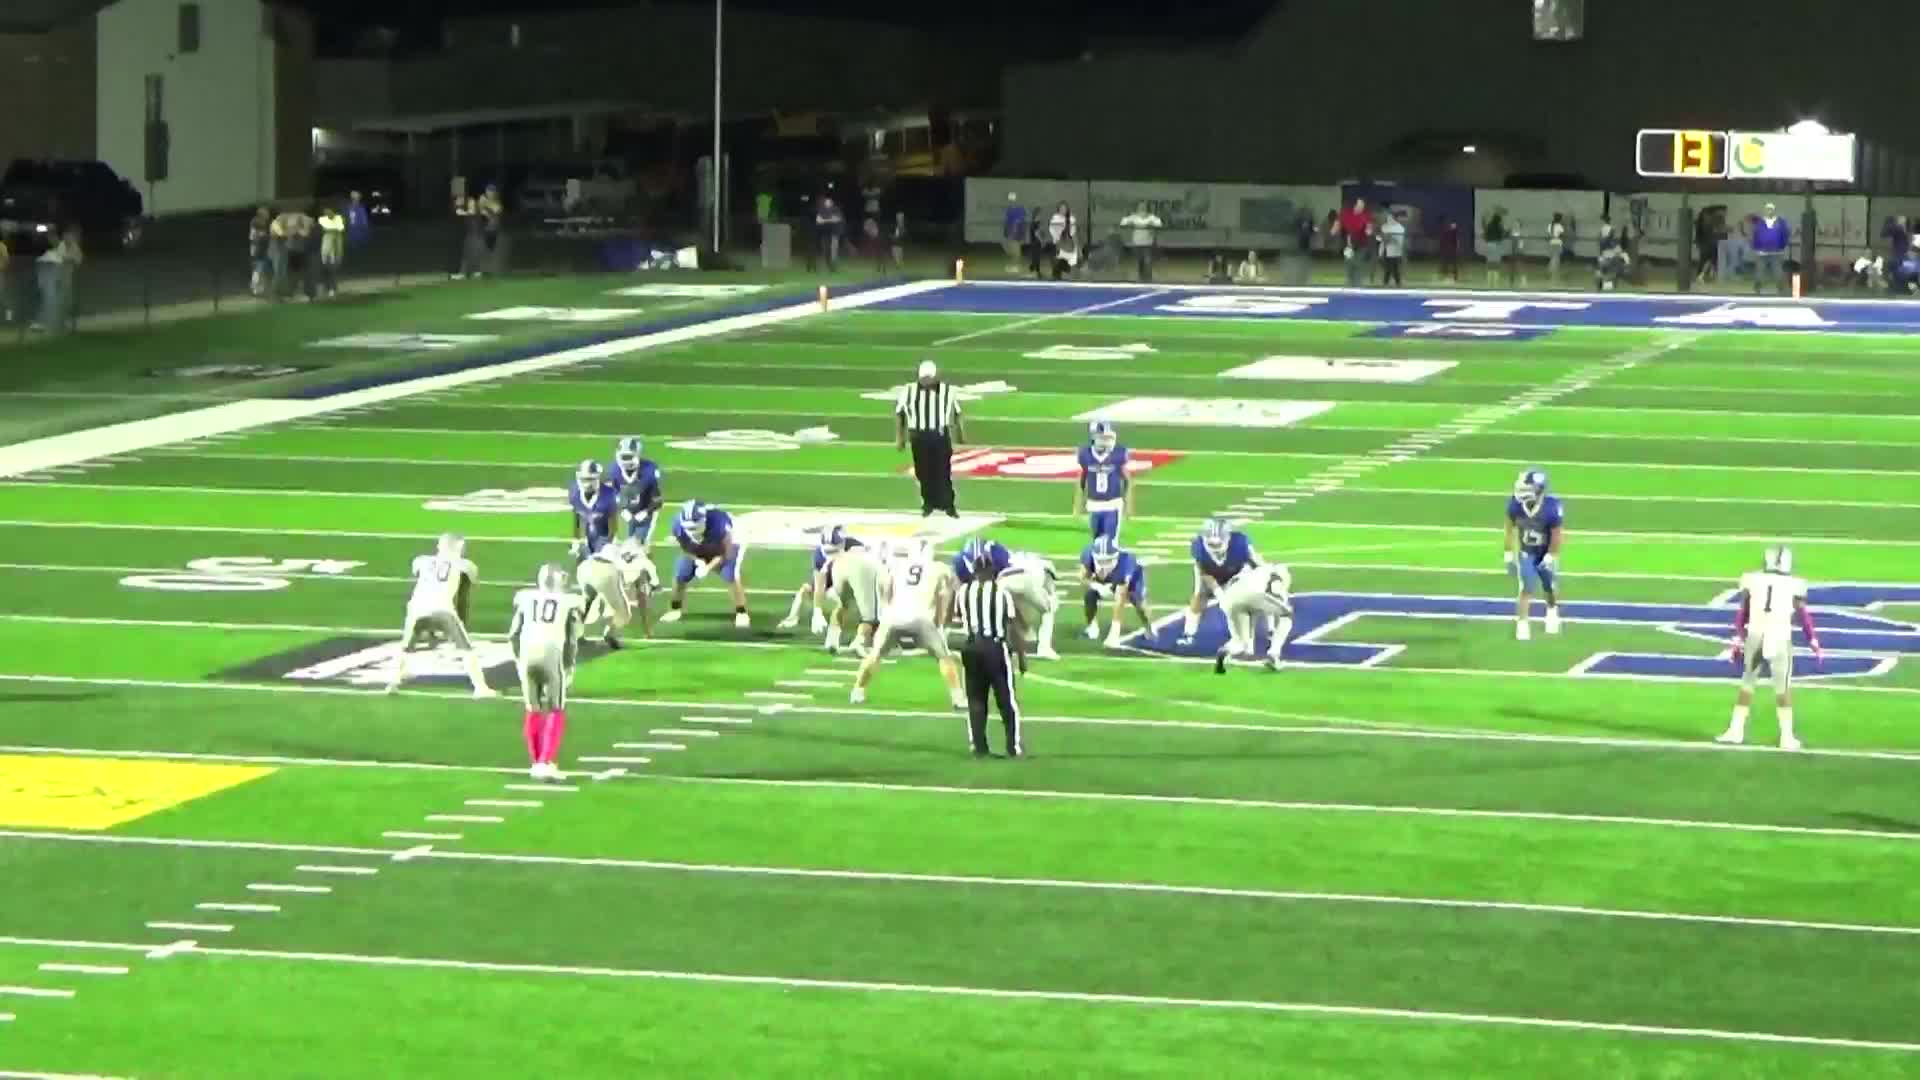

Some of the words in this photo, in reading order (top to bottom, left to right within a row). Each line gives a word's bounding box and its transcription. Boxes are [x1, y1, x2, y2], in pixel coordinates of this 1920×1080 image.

[906, 564, 924, 587] 9
[532, 598, 558, 624] 10
[1762, 584, 1774, 613] 1
